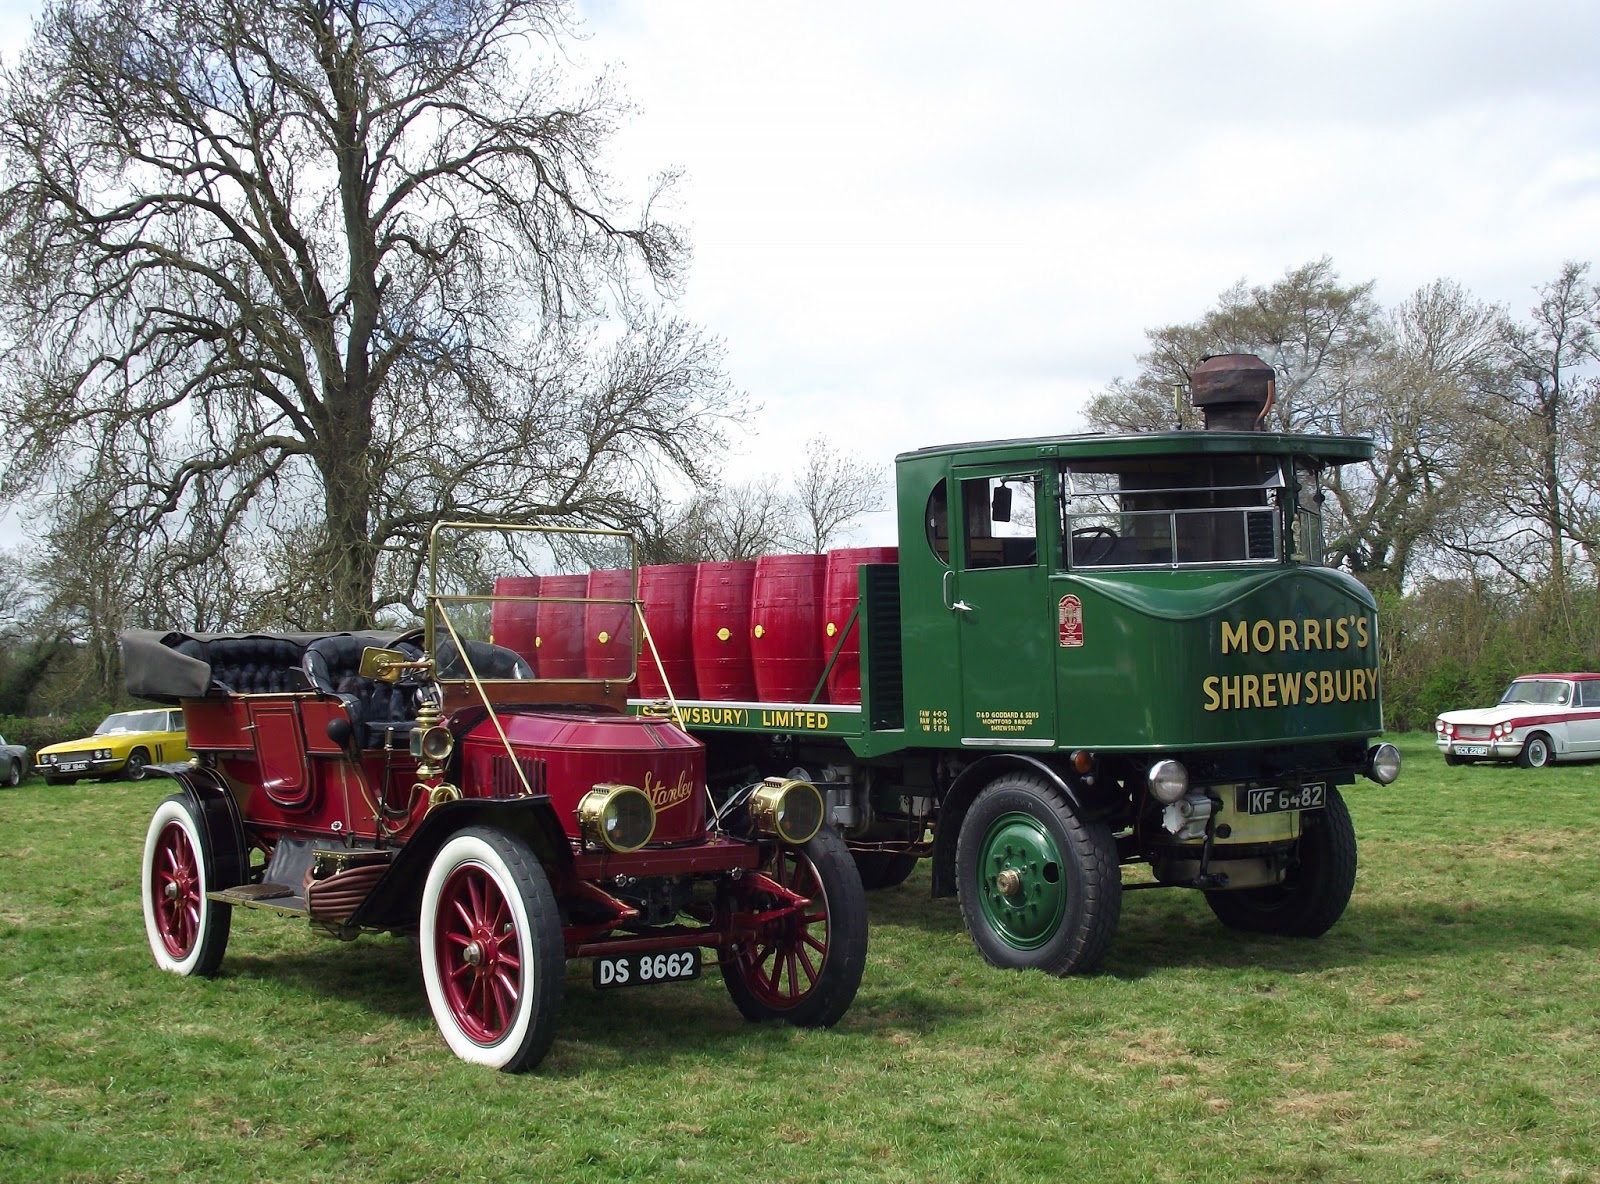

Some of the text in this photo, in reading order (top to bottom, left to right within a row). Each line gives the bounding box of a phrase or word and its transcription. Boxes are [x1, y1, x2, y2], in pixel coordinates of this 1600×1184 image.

[1221, 615, 1369, 654] MORRIS'S
[1203, 668, 1378, 711] SHREWSBURY
[762, 710, 829, 729] LIMITED
[991, 711, 1019, 719] GODDARD
[1025, 711, 1039, 719] SONS
[643, 770, 694, 813] Stanley
[1252, 790, 1275, 813] KF
[600, 951, 694, 985] DS 8662
